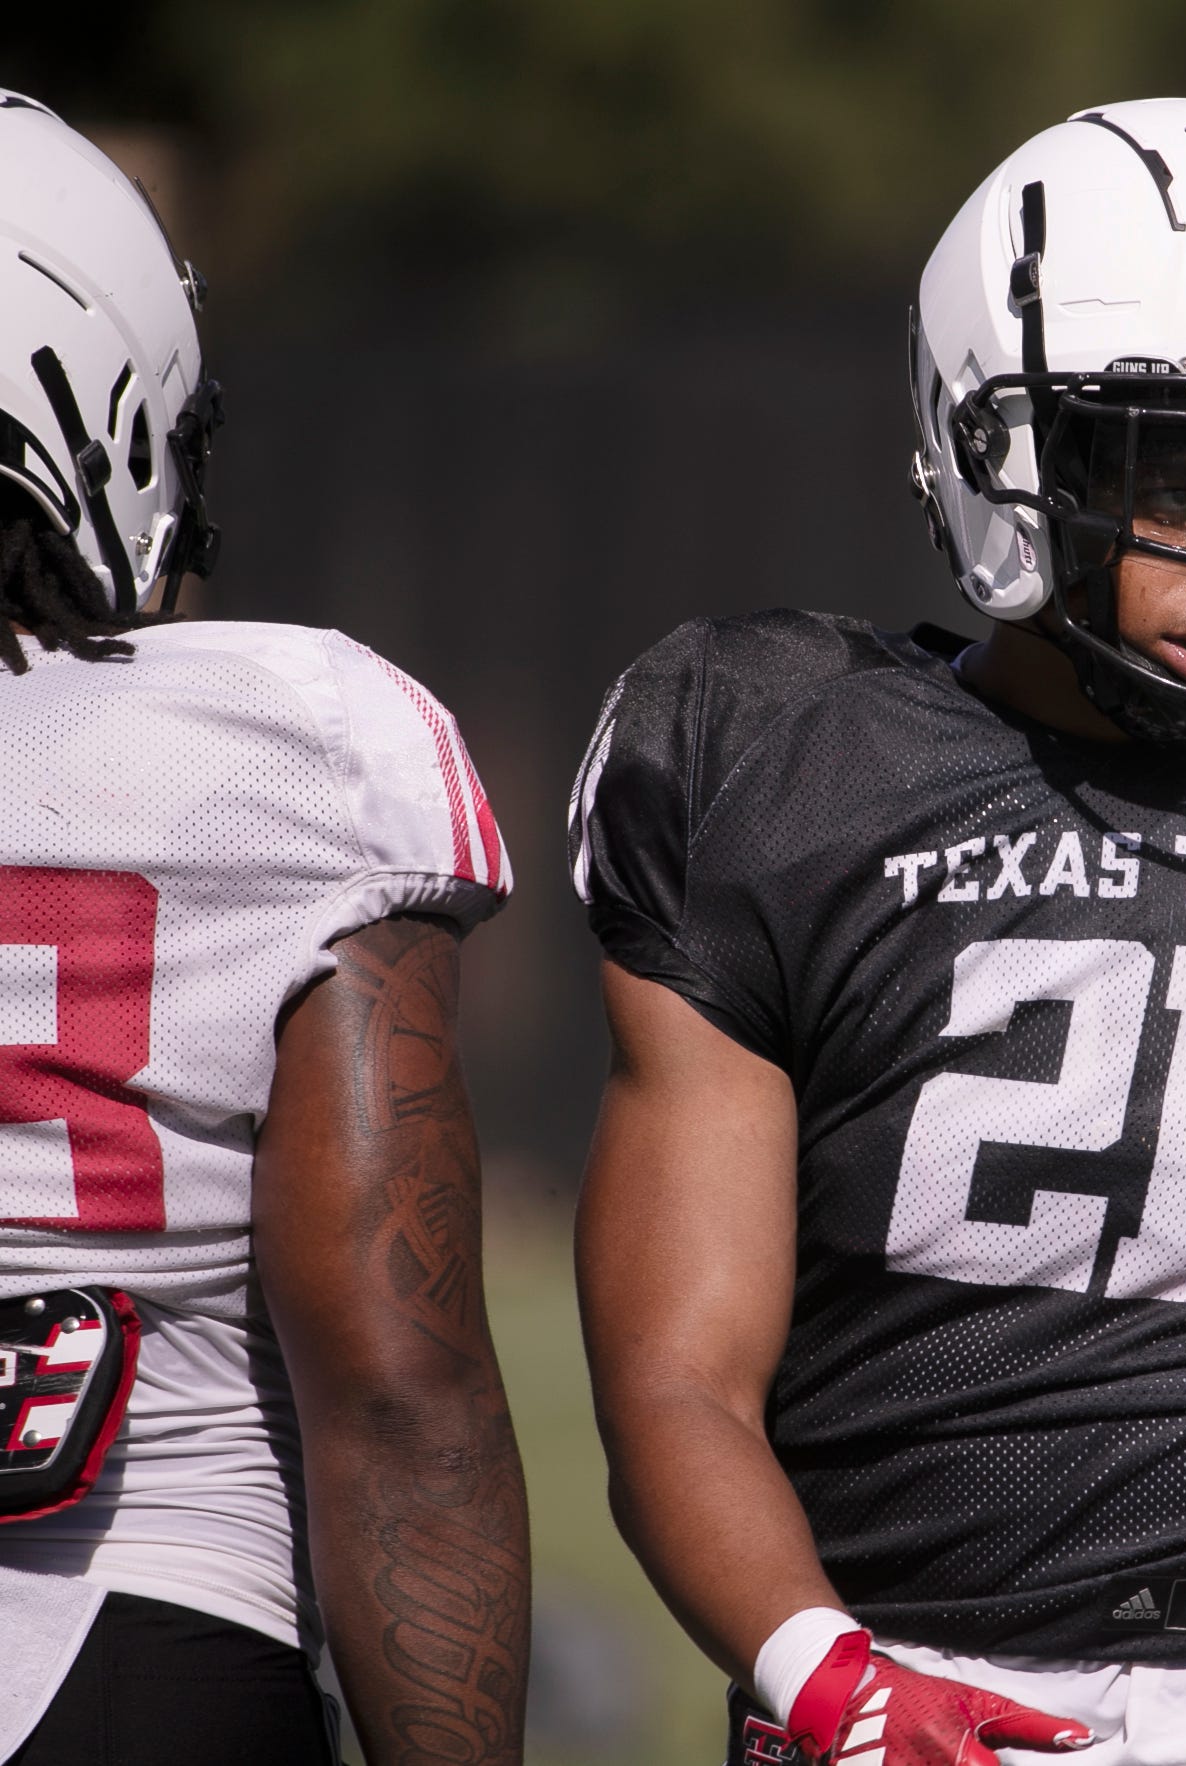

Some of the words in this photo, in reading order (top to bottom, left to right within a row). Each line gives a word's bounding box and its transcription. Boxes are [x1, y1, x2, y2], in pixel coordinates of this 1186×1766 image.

[1112, 361, 1147, 374] GUNS
[1151, 363, 1170, 375] UP
[884, 830, 1142, 909] TEXAS
[1112, 1608, 1161, 1620] adidas
